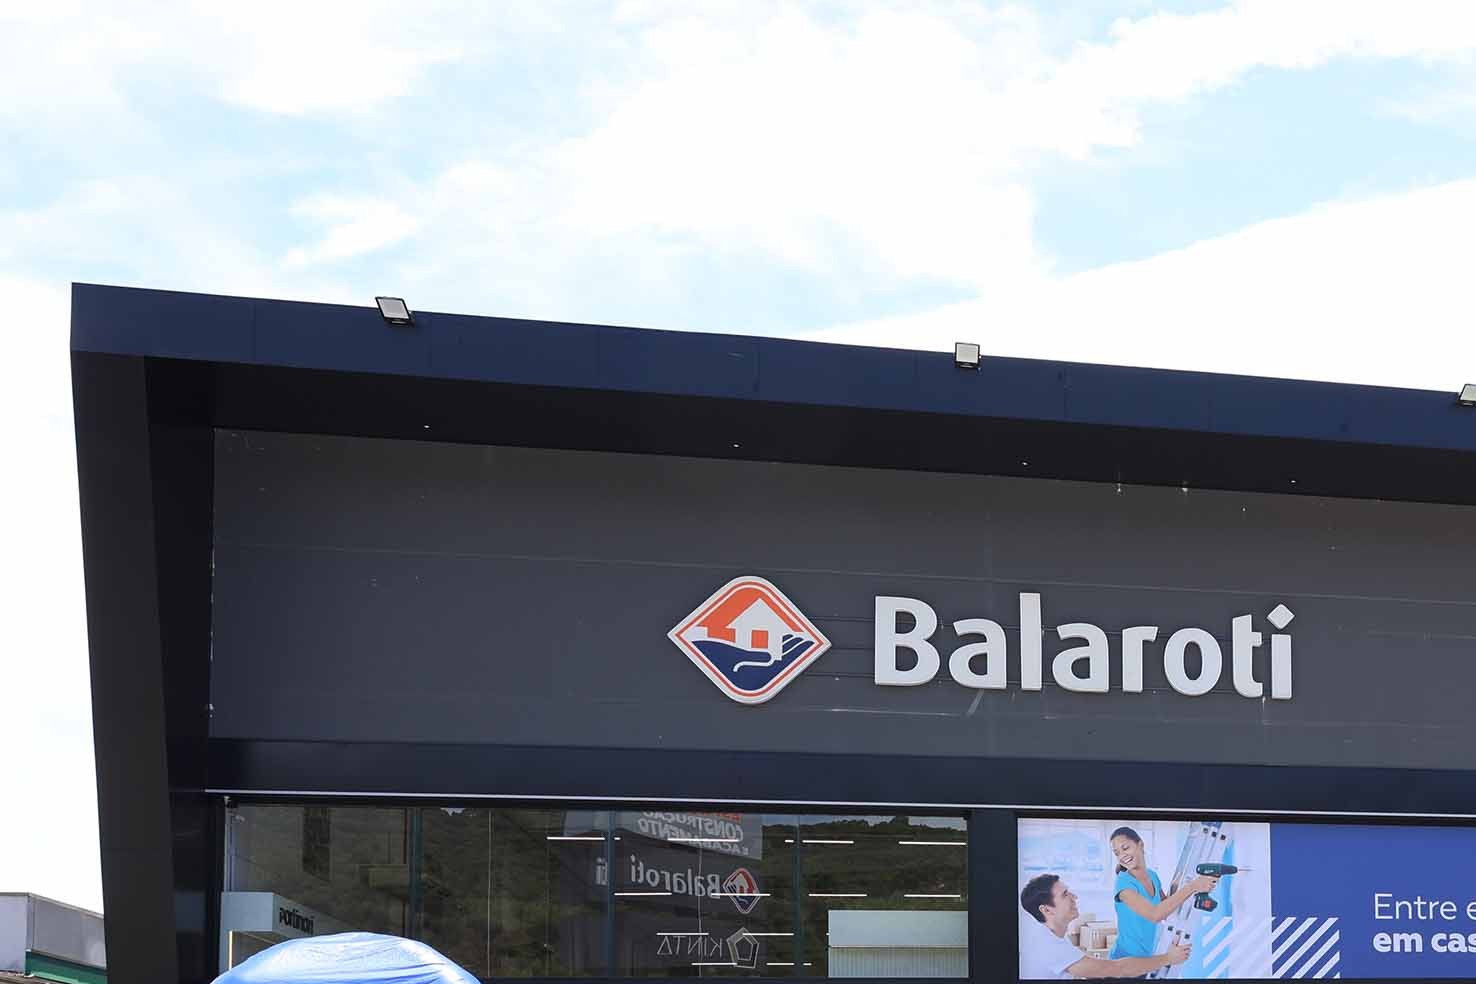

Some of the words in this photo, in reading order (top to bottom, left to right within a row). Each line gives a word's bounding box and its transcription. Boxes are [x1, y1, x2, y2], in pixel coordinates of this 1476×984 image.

[874, 592, 1295, 700] Balaroti
[1374, 893, 1457, 920] Entre
[1373, 932, 1423, 953] em
